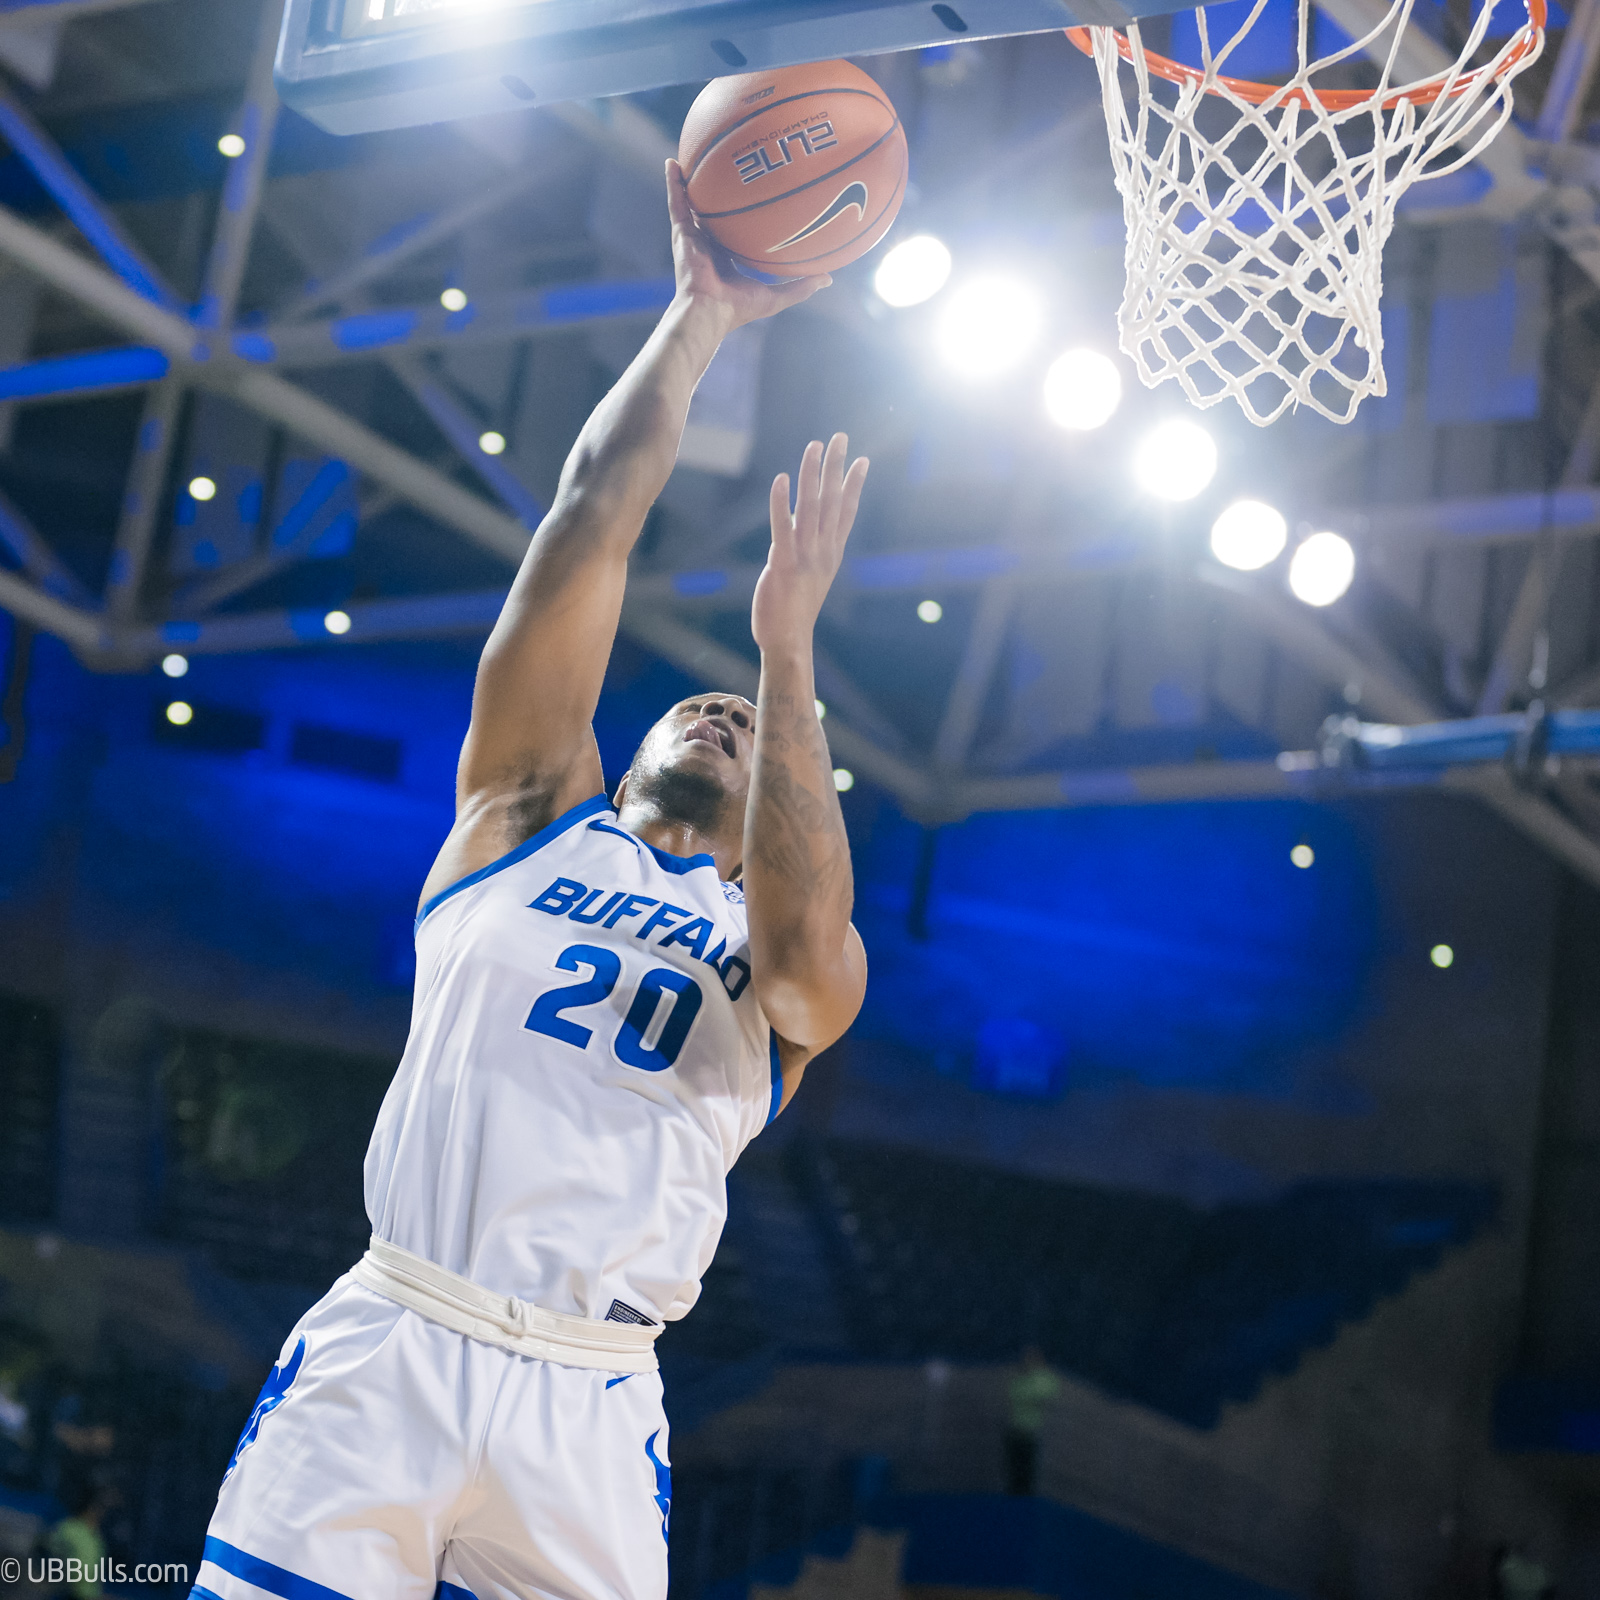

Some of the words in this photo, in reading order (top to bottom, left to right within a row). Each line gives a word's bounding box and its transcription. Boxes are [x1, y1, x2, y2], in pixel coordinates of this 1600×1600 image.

[731, 111, 829, 158] CHAMPIONSHIP
[734, 120, 838, 185] ELITE
[519, 943, 703, 1072] 20
